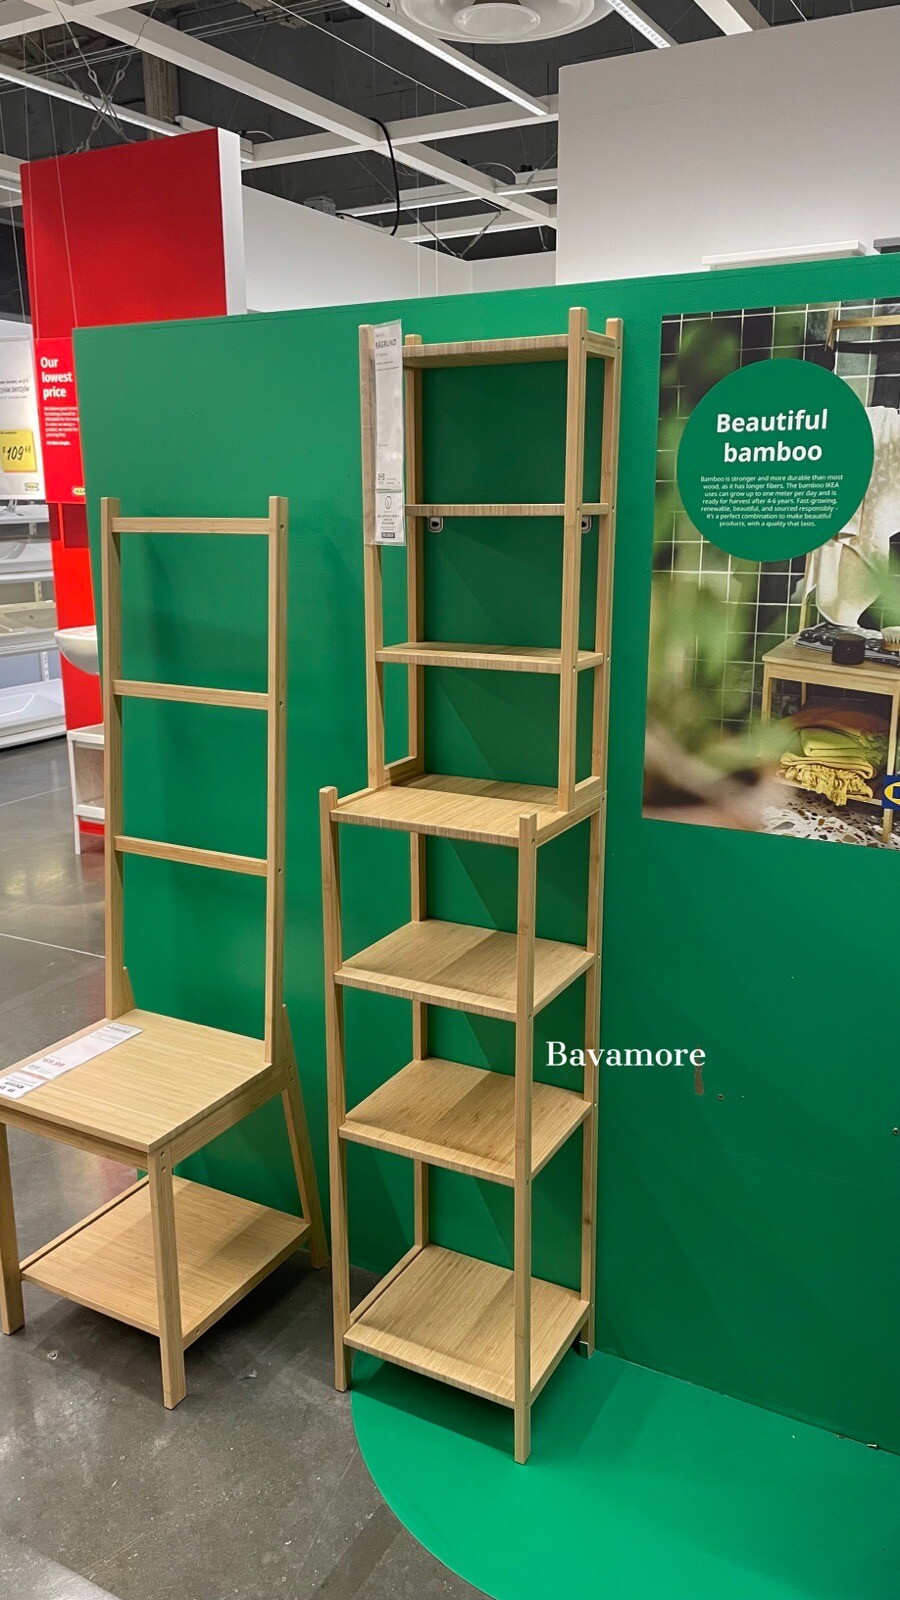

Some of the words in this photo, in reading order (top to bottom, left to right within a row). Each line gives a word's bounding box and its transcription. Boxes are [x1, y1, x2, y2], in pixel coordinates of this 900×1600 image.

[40, 357, 59, 369] Our
[42, 372, 73, 383] lowest
[43, 387, 67, 400] price
[716, 408, 828, 434] Beautiful
[724, 441, 823, 463] bamboo
[731, 475, 756, 483] stronger
[746, 483, 765, 491] longer
[806, 490, 817, 498] day
[703, 498, 719, 506] ready
